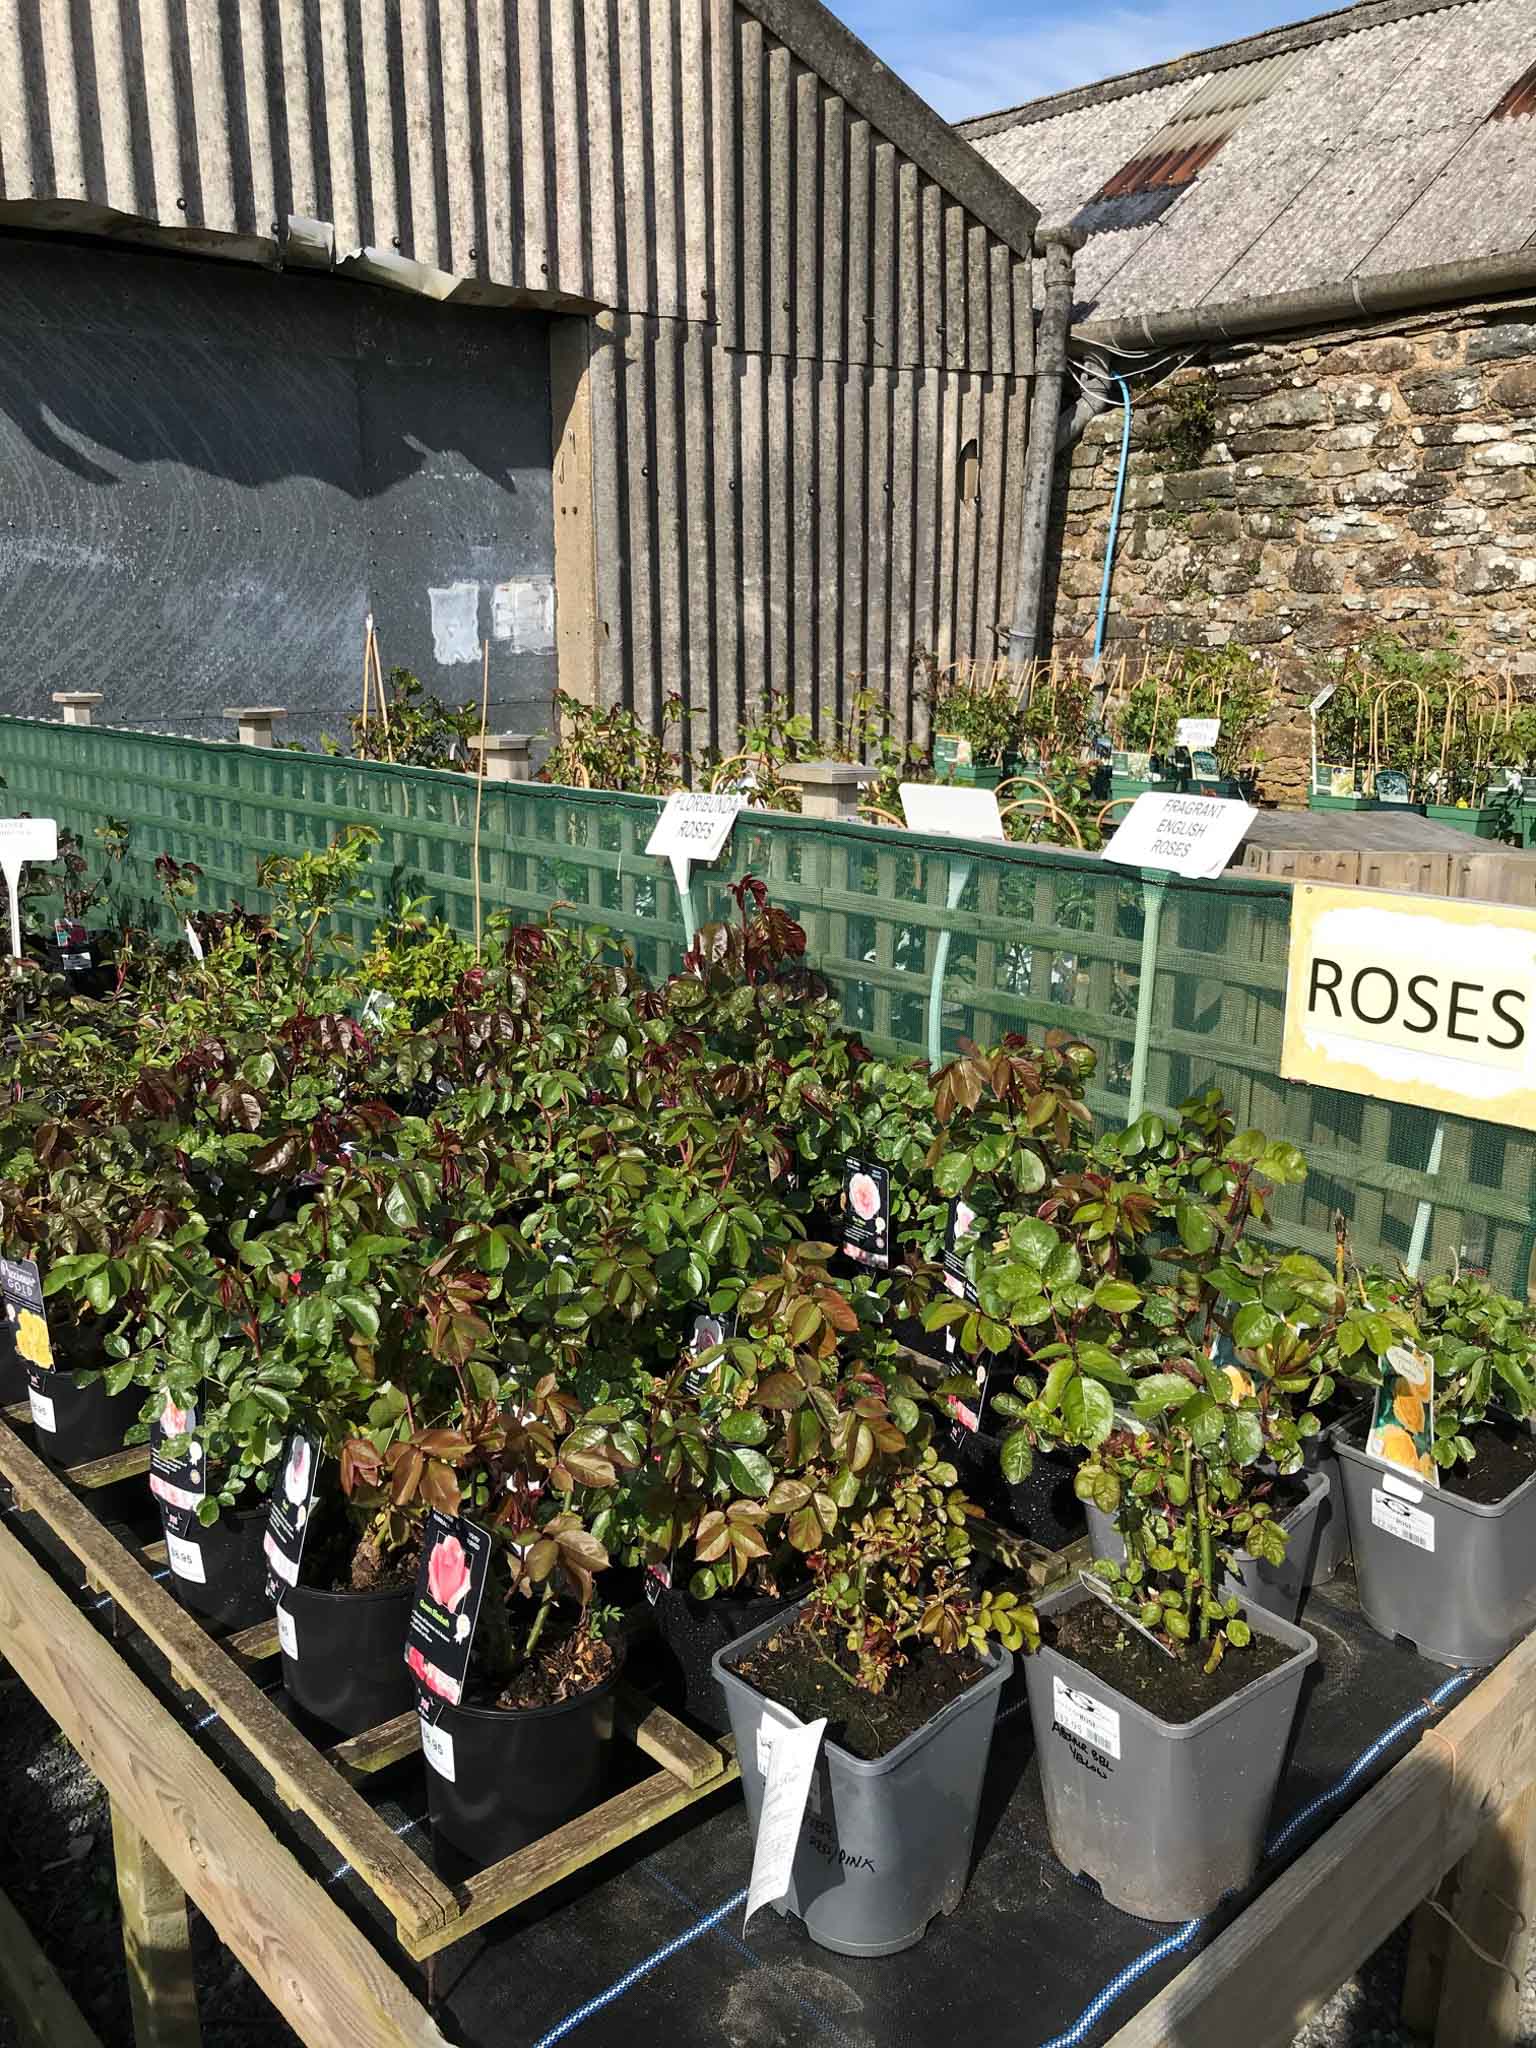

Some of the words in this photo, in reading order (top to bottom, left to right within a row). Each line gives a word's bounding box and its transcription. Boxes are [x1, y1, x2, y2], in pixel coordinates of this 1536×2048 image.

[1162, 799, 1226, 818] FRAGRANT
[679, 820, 715, 840] ROSES
[1156, 818, 1208, 837] ENGLISH
[1150, 839, 1192, 858] ROSES
[1307, 957, 1527, 1050] ROSES
